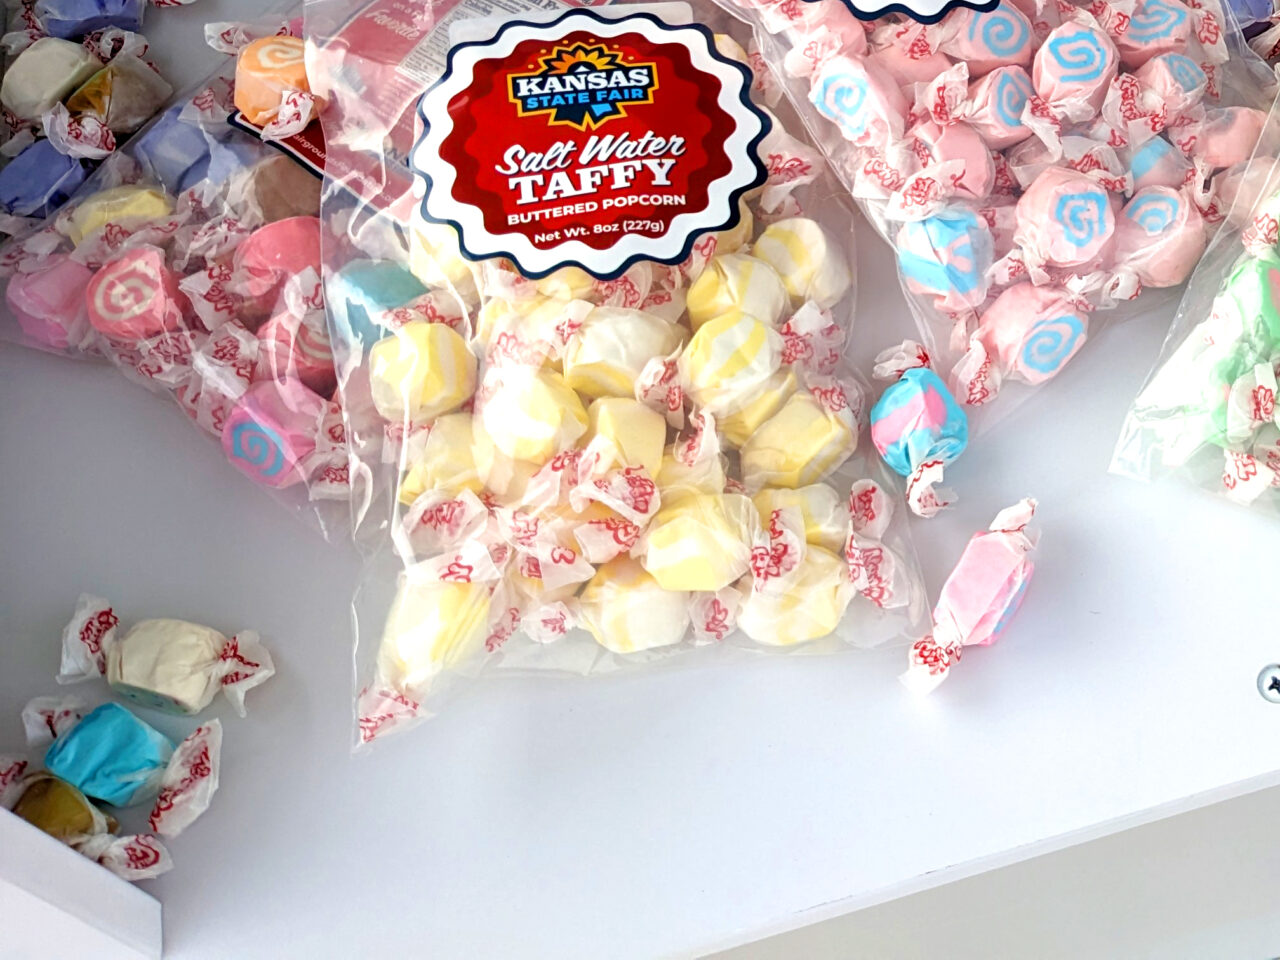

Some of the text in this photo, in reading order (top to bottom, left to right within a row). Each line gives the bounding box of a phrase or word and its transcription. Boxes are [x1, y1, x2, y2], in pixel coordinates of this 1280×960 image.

[516, 67, 650, 97] KANSAS
[526, 88, 644, 109] STATE FAIR
[495, 130, 686, 175] Salt Water
[508, 158, 677, 205] TAFFY
[507, 194, 686, 226] BUTTERED POPCORN
[534, 219, 665, 244] Net Wt. 8oz (227g)
